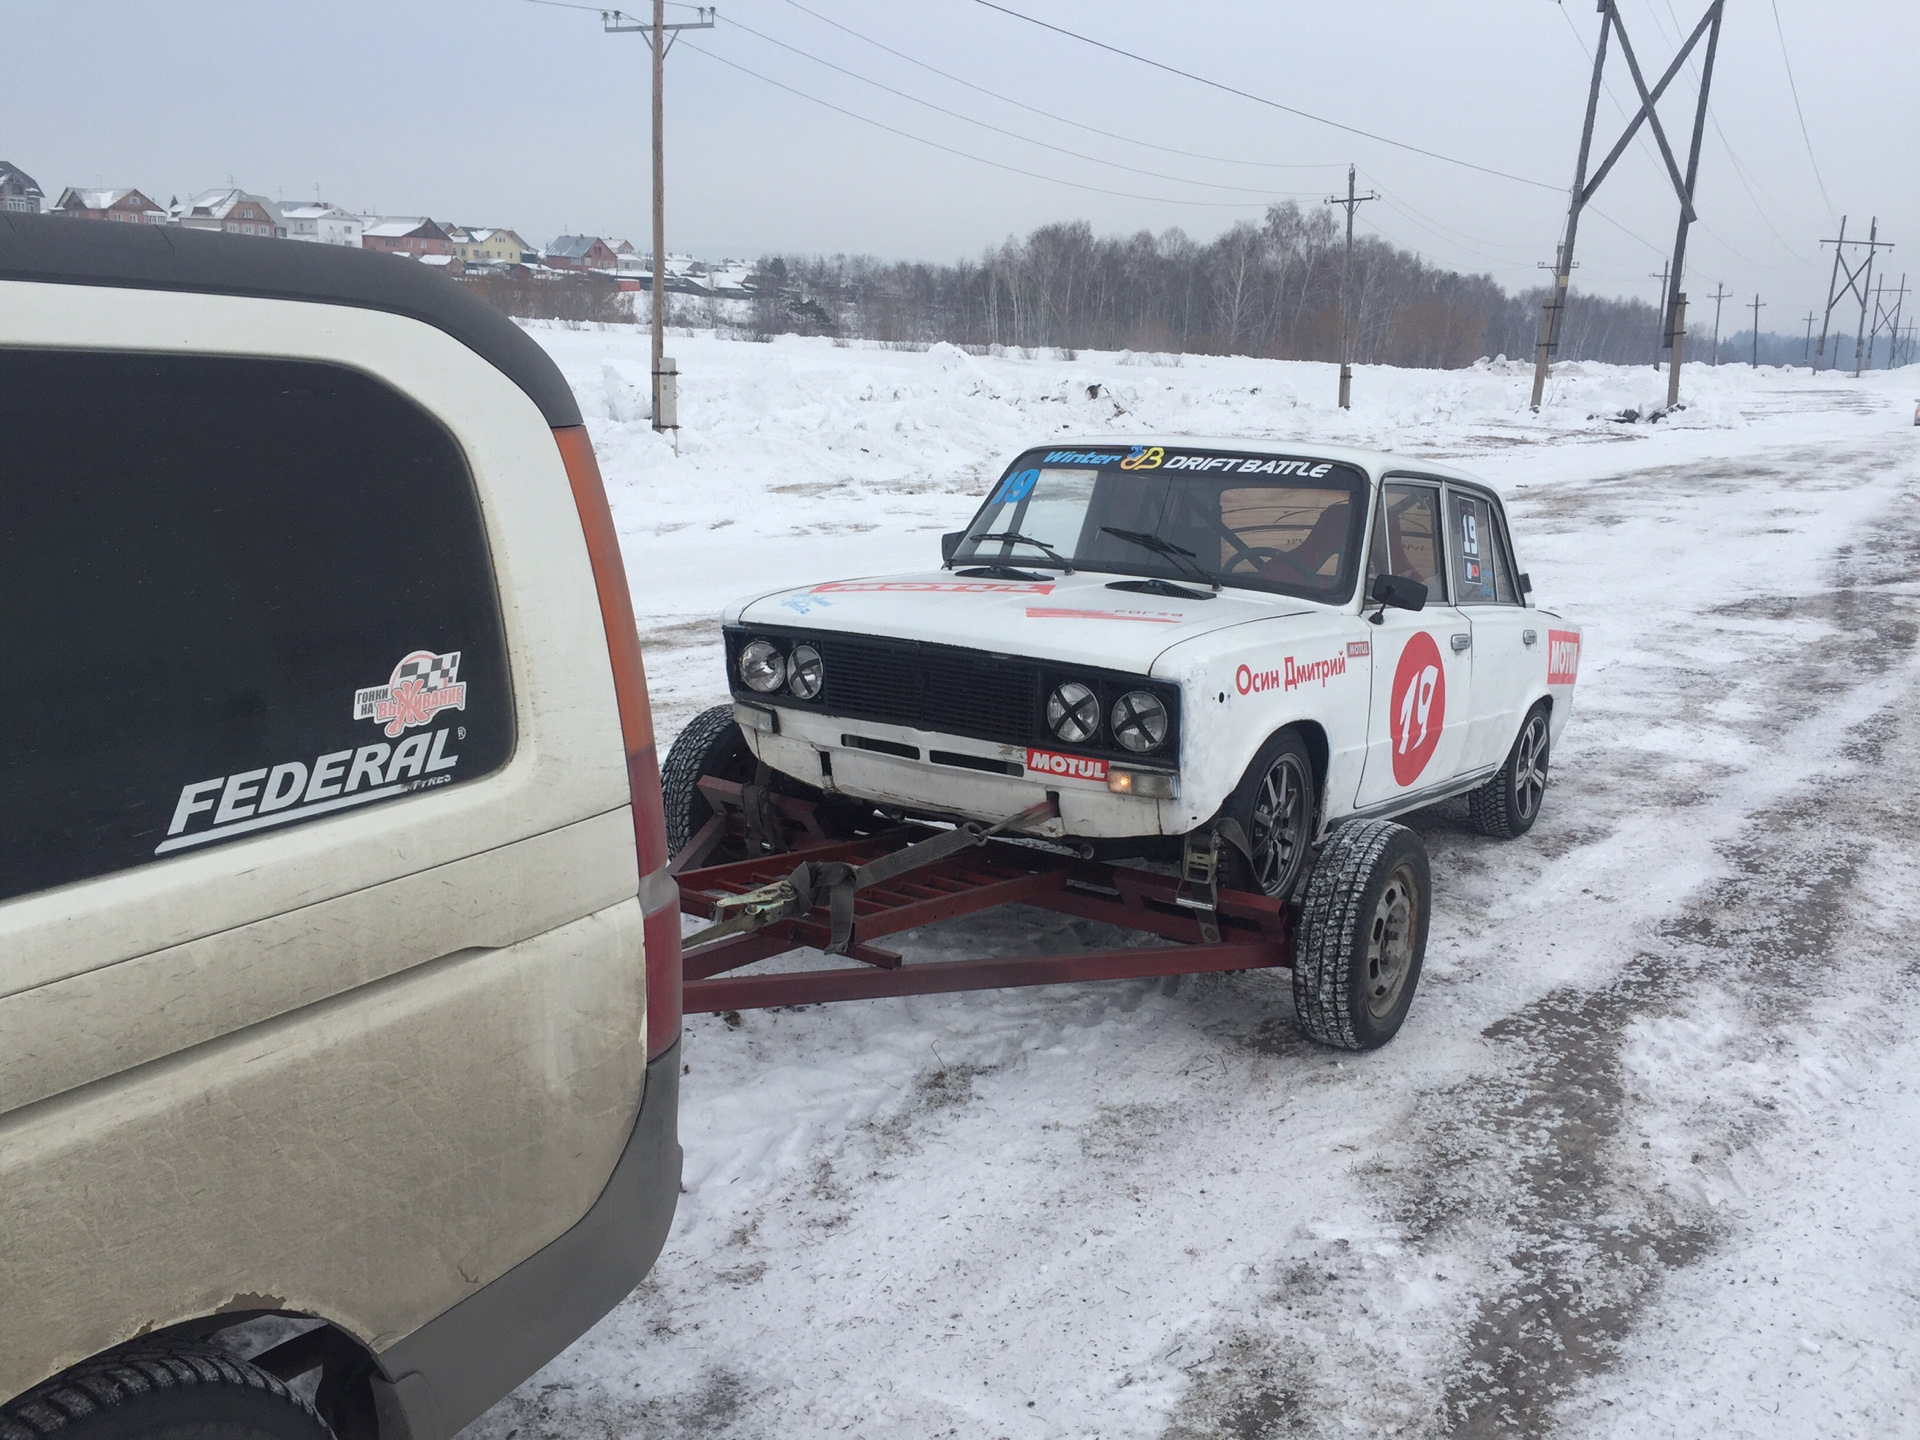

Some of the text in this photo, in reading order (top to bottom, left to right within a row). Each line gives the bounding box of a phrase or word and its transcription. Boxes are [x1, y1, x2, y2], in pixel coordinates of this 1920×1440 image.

[1043, 451, 1122, 466] Winter
[1163, 455, 1243, 473] DRIFT
[1237, 458, 1333, 478] BATTLE
[991, 468, 1040, 506] 19
[1462, 514, 1479, 555] 19
[1349, 643, 1369, 655] MOTUL
[1235, 650, 1346, 696] Осин Дмитрий
[356, 687, 389, 705] ГОНКИ
[360, 701, 374, 716] НА
[1399, 665, 1439, 755] 19
[1030, 752, 1106, 779] MOTUL
[167, 728, 459, 836] FEDERAL
